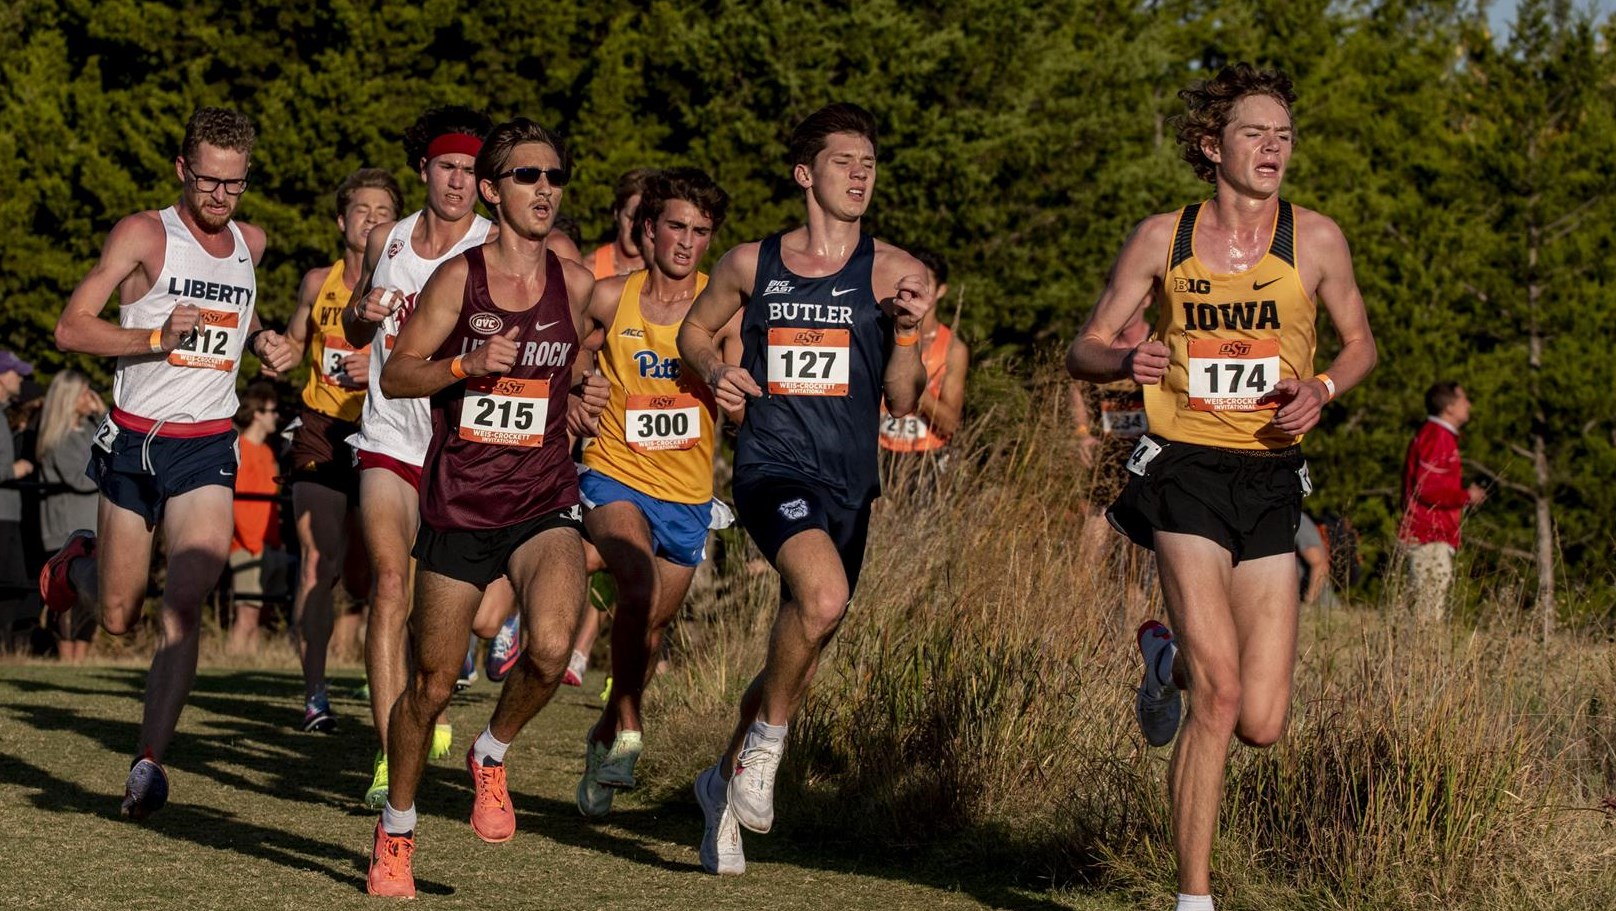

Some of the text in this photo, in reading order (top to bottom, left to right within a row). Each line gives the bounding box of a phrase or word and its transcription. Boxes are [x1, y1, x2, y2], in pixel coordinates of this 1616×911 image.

[764, 286, 796, 294] EAST
[769, 279, 790, 287] BIG
[168, 277, 253, 306] LIBERTY
[768, 302, 854, 324] BUTLER
[1182, 300, 1281, 331] IOWA
[621, 328, 645, 338] ACC
[794, 330, 824, 346] OSU
[521, 341, 572, 367] ROCK
[1219, 341, 1251, 357] OSU
[633, 349, 682, 381] Pitt
[780, 350, 837, 379] 127
[1204, 363, 1267, 393] 174
[493, 380, 526, 395] OSU
[779, 382, 836, 391] WEIS-CROCKETT
[474, 398, 534, 430] 215
[637, 413, 689, 438] 300
[473, 428, 531, 440] WEIS-CROCKETT
[481, 436, 520, 445] INVITATIONAL
[638, 439, 688, 448] WEIS-CROCKETT
